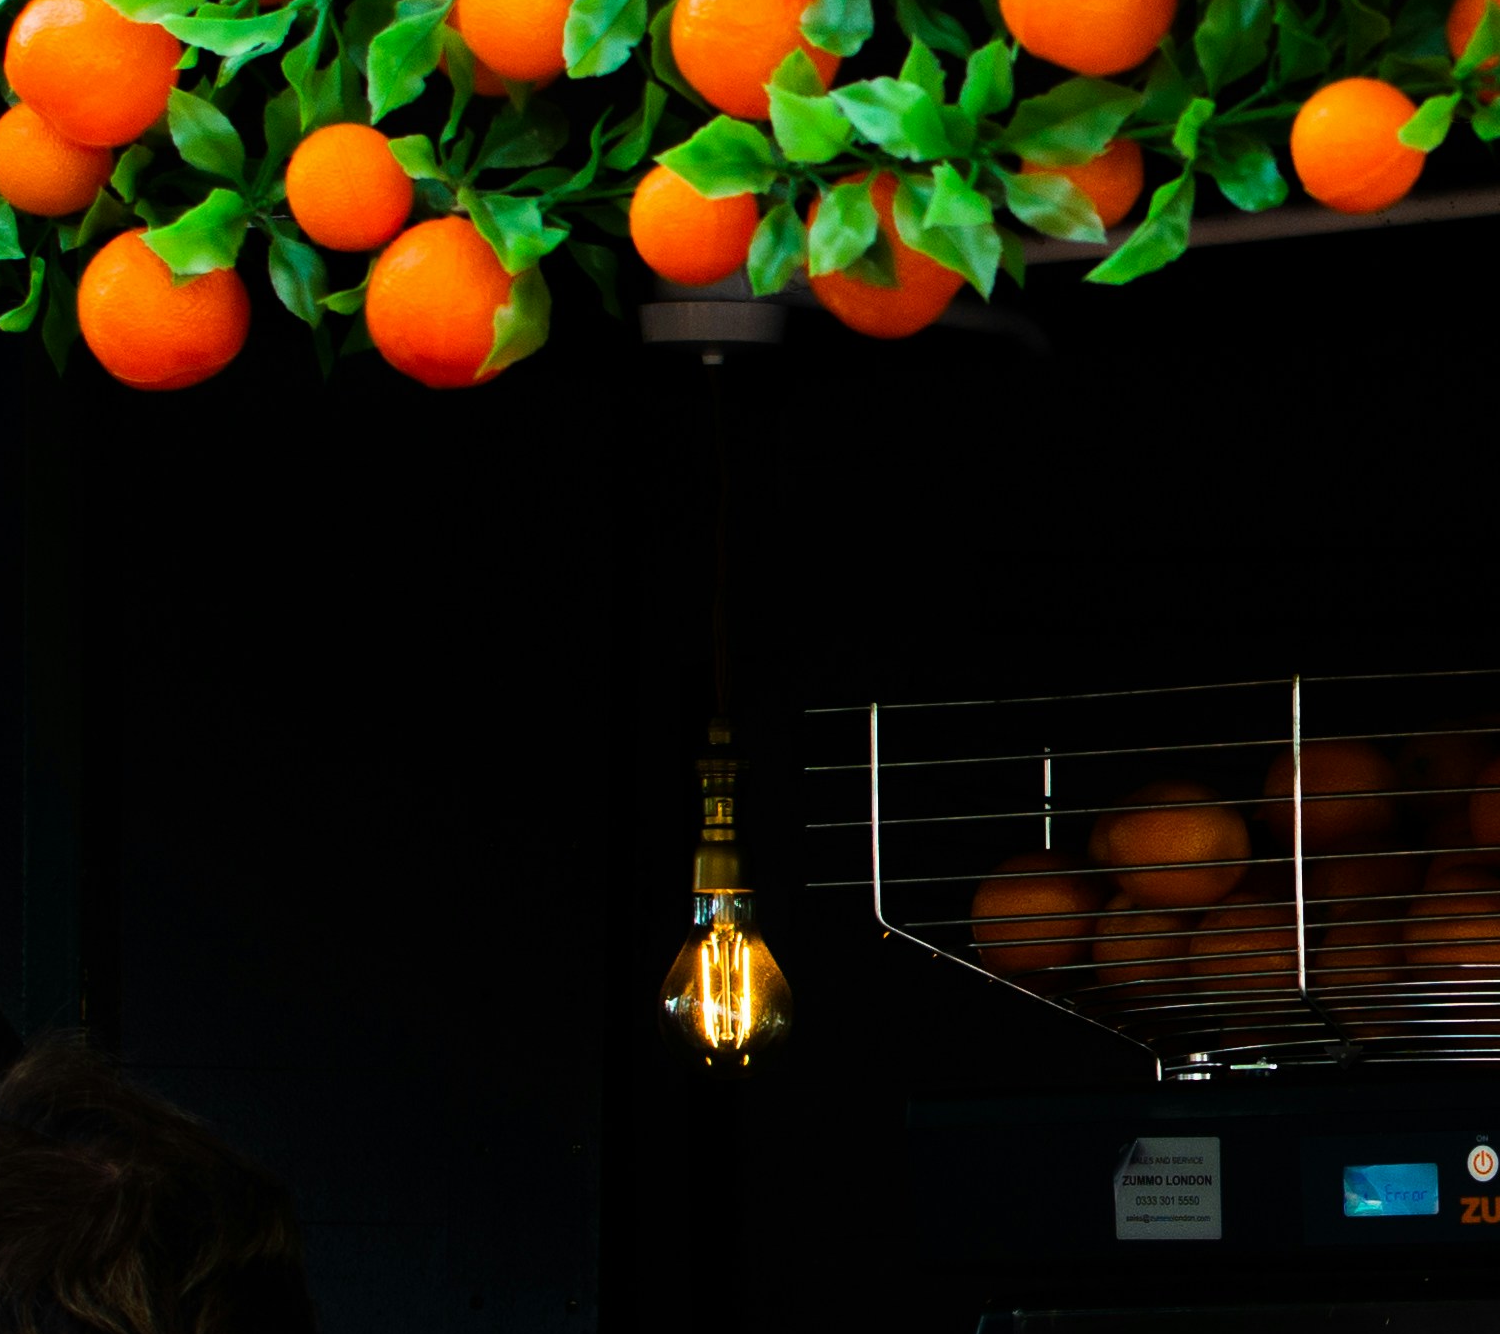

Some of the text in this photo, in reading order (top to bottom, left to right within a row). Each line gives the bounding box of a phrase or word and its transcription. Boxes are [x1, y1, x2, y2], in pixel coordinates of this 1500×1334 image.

[1476, 1134, 1489, 1142] ON
[1155, 1156, 1170, 1165] AND
[1122, 1175, 1212, 1186] ZUMMO LONDON
[1136, 1196, 1200, 1206] 0333 301 5550
